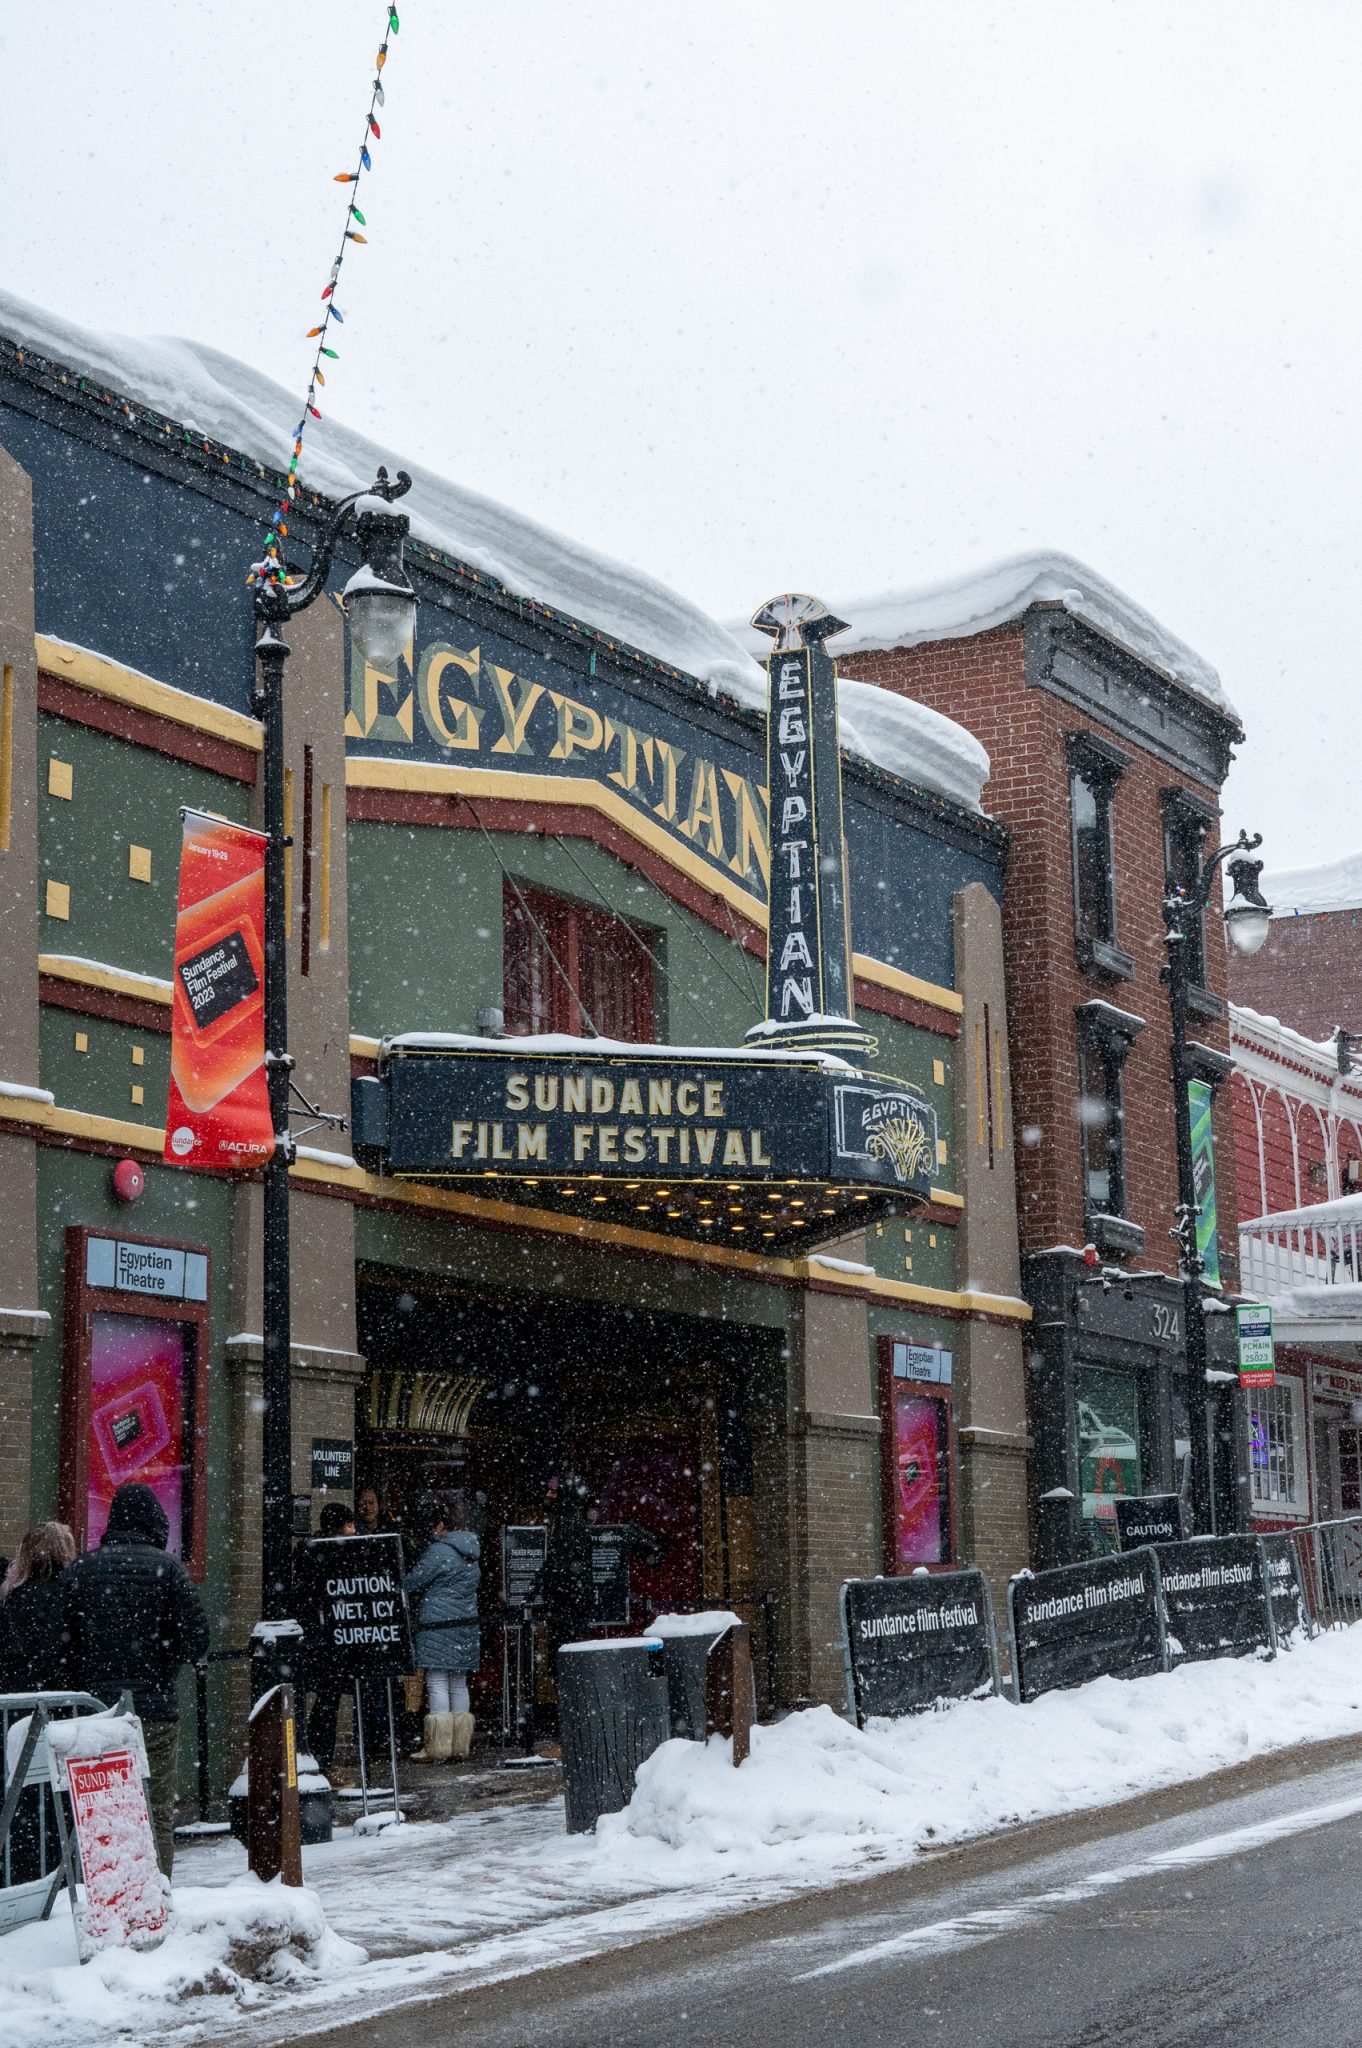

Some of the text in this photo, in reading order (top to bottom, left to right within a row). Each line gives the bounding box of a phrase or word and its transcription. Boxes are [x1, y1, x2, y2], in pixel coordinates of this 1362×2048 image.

[188, 841, 211, 858] January
[778, 661, 815, 1017] EGYPTIAN
[182, 947, 226, 982] Sundance
[187, 954, 239, 996] Film Festival
[191, 986, 216, 1011] 2023
[505, 1074, 725, 1118] SUNDANCE
[171, 1136, 203, 1147] sundance
[227, 1141, 268, 1154] ACURA
[451, 1121, 772, 1167] FILM FESTIVAL
[119, 1246, 172, 1271] Egyptian
[119, 1267, 166, 1290] Theatre
[1152, 1303, 1180, 1341] 324
[908, 1348, 934, 1364] Egyptian
[1242, 1342, 1270, 1351] PCMAIN
[908, 1363, 932, 1378] Theatre
[312, 1450, 352, 1463] VOLUNTEER
[324, 1465, 340, 1477] LINE
[326, 1576, 396, 1597] CAUTION:
[1201, 1569, 1220, 1586] film
[1027, 1573, 1145, 1624] sundance film festival
[331, 1601, 396, 1622] WET, ICY
[860, 1602, 978, 1639] sundance film festival
[333, 1625, 401, 1645] SURFACE
